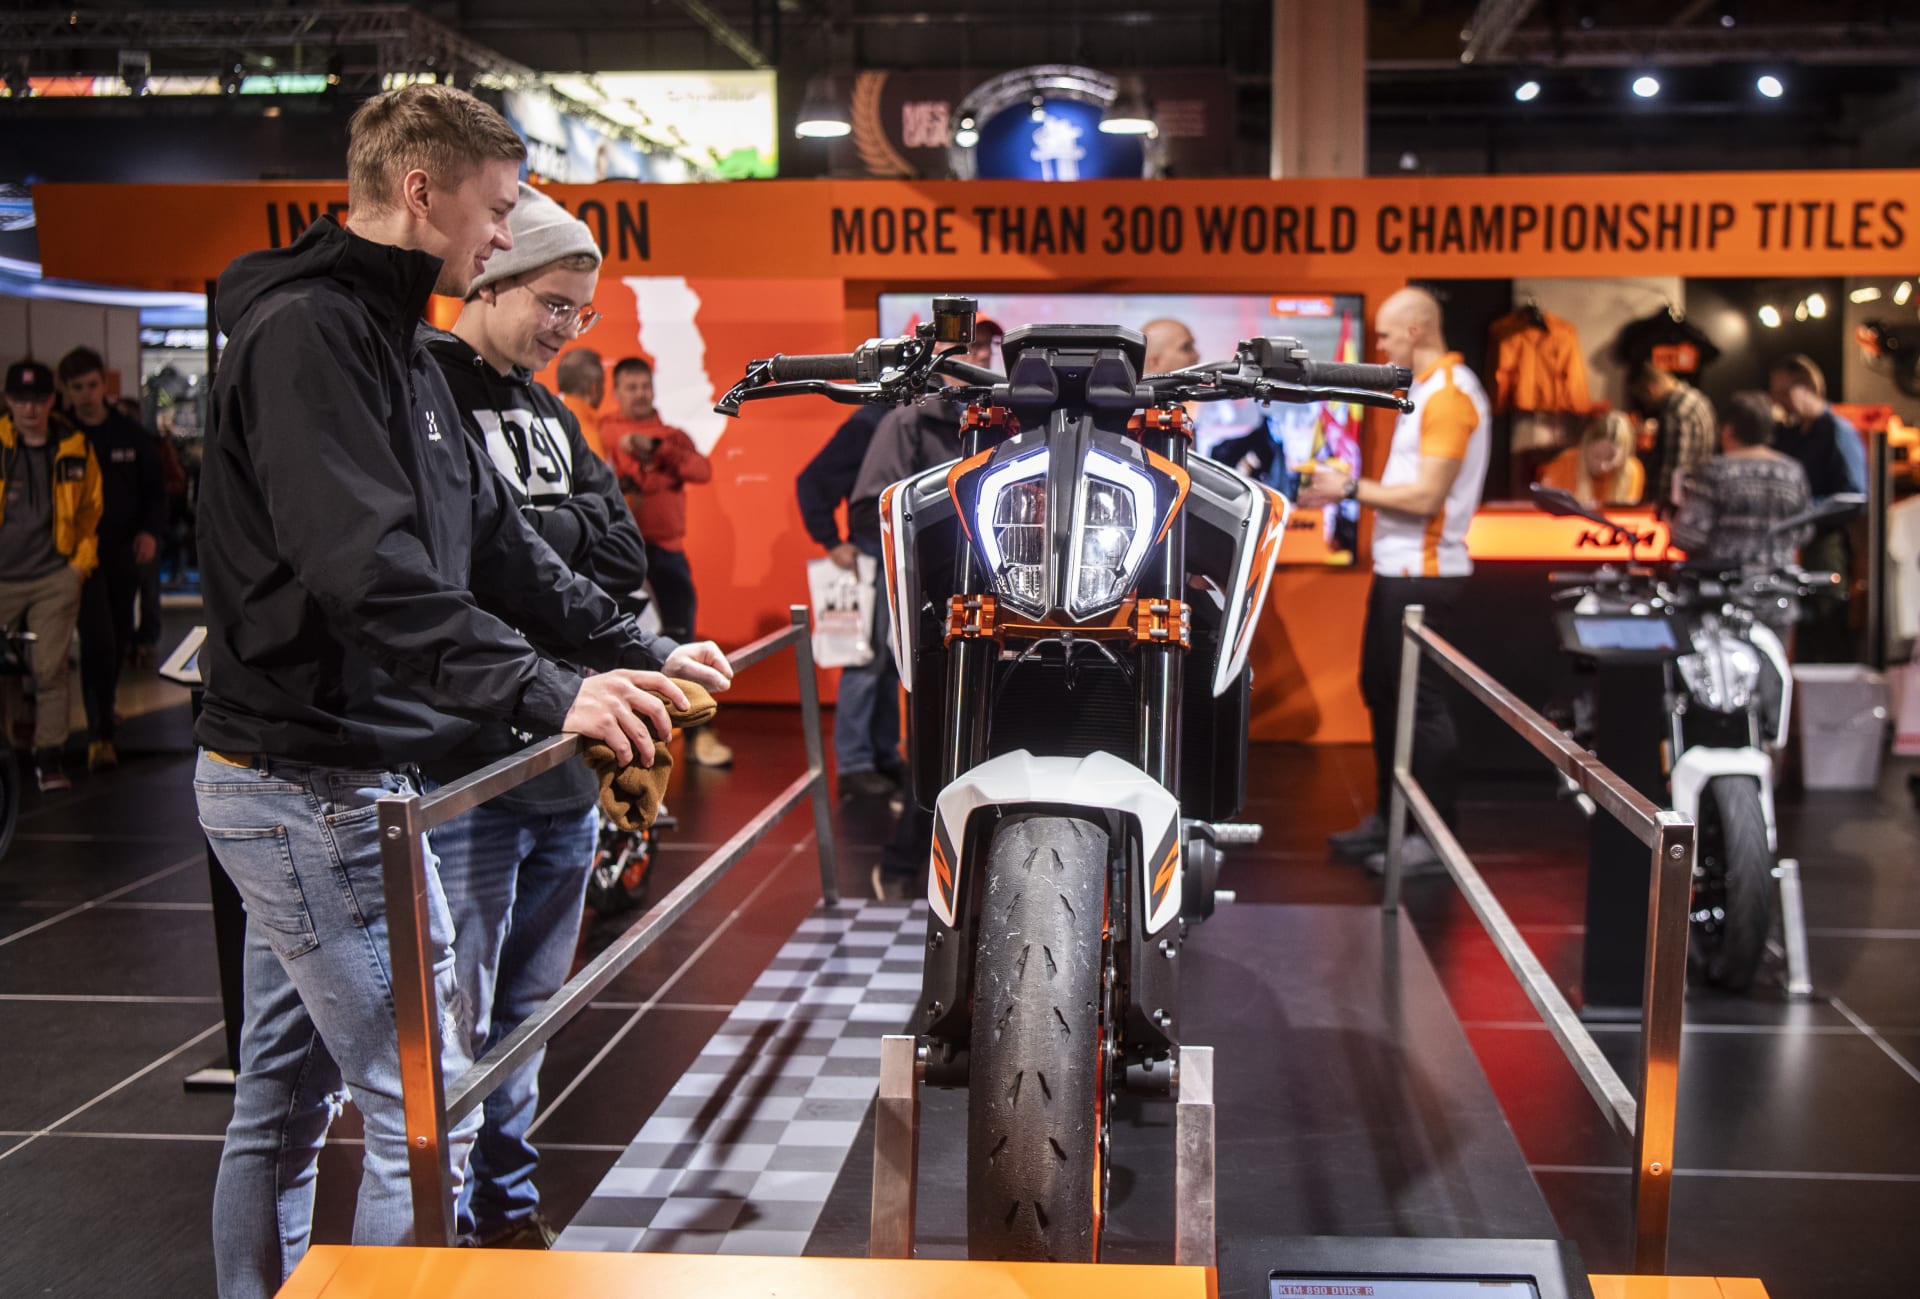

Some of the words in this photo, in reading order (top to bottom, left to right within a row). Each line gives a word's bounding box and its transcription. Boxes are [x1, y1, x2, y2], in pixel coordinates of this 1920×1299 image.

[831, 205, 957, 255] MORE
[972, 205, 1086, 255] THAN
[1101, 204, 1184, 256] 300
[1196, 204, 1357, 255] WORLD
[1376, 202, 1736, 255] CHAMPIONSHIP
[1753, 200, 1907, 251] TITLES
[1279, 1285, 1303, 1295] KTM
[1305, 1285, 1329, 1295] 890
[1331, 1285, 1361, 1296] DUKE
[1365, 1286, 1374, 1295] R
